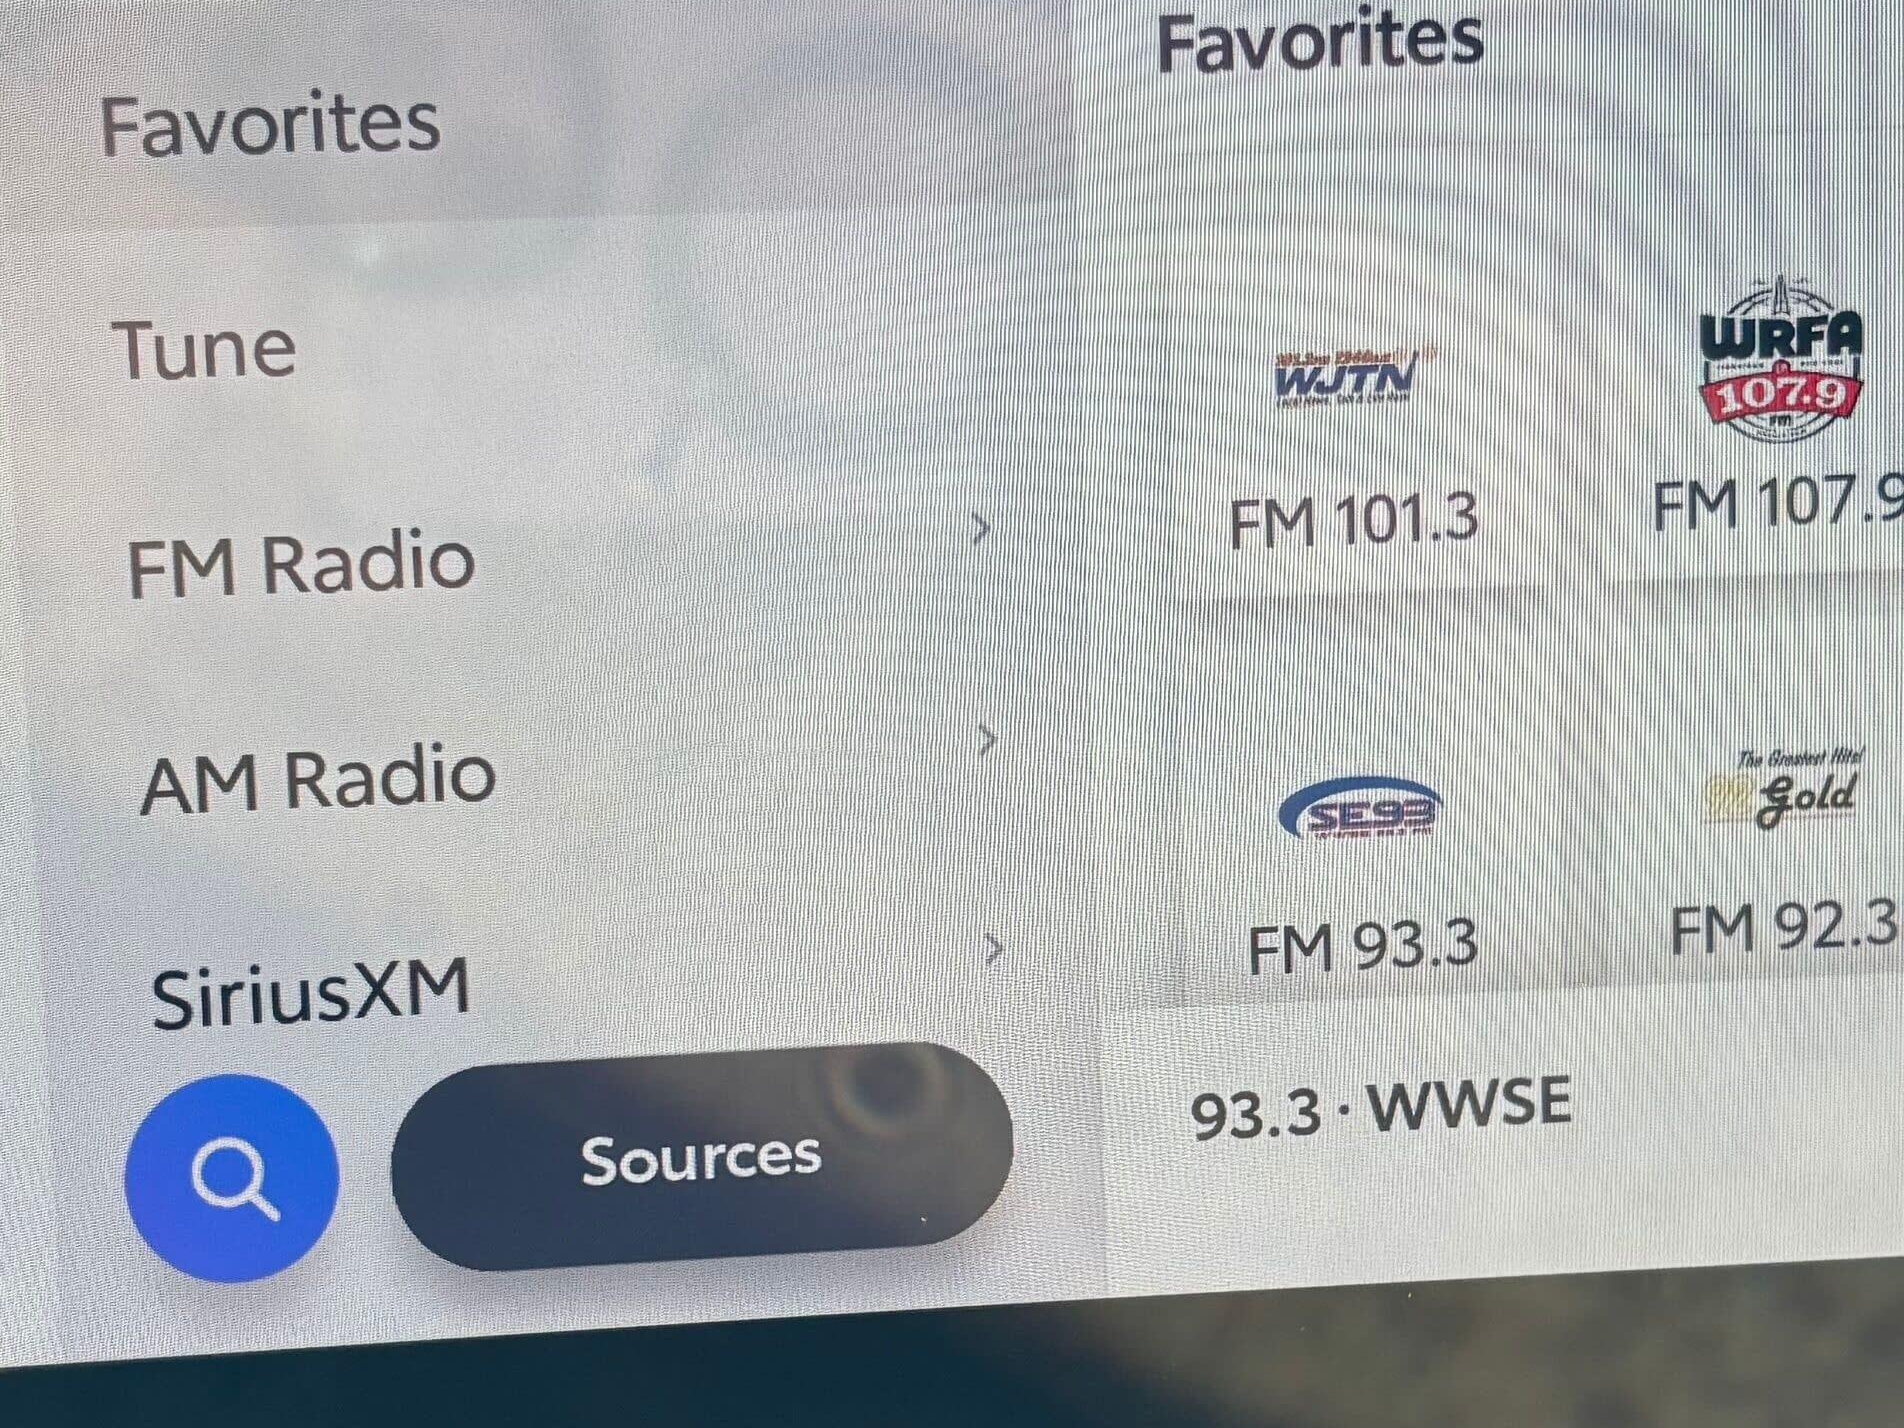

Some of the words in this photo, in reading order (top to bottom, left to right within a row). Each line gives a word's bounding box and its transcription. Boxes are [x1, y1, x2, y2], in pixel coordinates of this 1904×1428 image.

[1156, 3, 1485, 74] Favorites
[102, 87, 440, 157] Favorites
[111, 320, 296, 380] Tune
[1700, 310, 1862, 360] WRFA
[1275, 349, 1419, 397] WJTN
[1716, 377, 1846, 414] 107.9
[1230, 499, 1317, 550] FM
[1335, 490, 1479, 546] 101.3
[1655, 481, 1739, 531] FM
[129, 538, 235, 599] FM
[263, 527, 475, 594] Radio
[140, 754, 258, 816] AM
[286, 741, 497, 809] Radio
[1756, 771, 1859, 830] Gold
[1249, 926, 1334, 975] FM
[1350, 916, 1479, 970] 93.3
[1672, 905, 1754, 954] FM
[1772, 896, 1900, 950] 92.3
[152, 956, 469, 1031] SiriusXM
[1190, 1087, 1323, 1142] 93.3
[1365, 1075, 1573, 1133] WWSE
[580, 1134, 823, 1187] Sources
